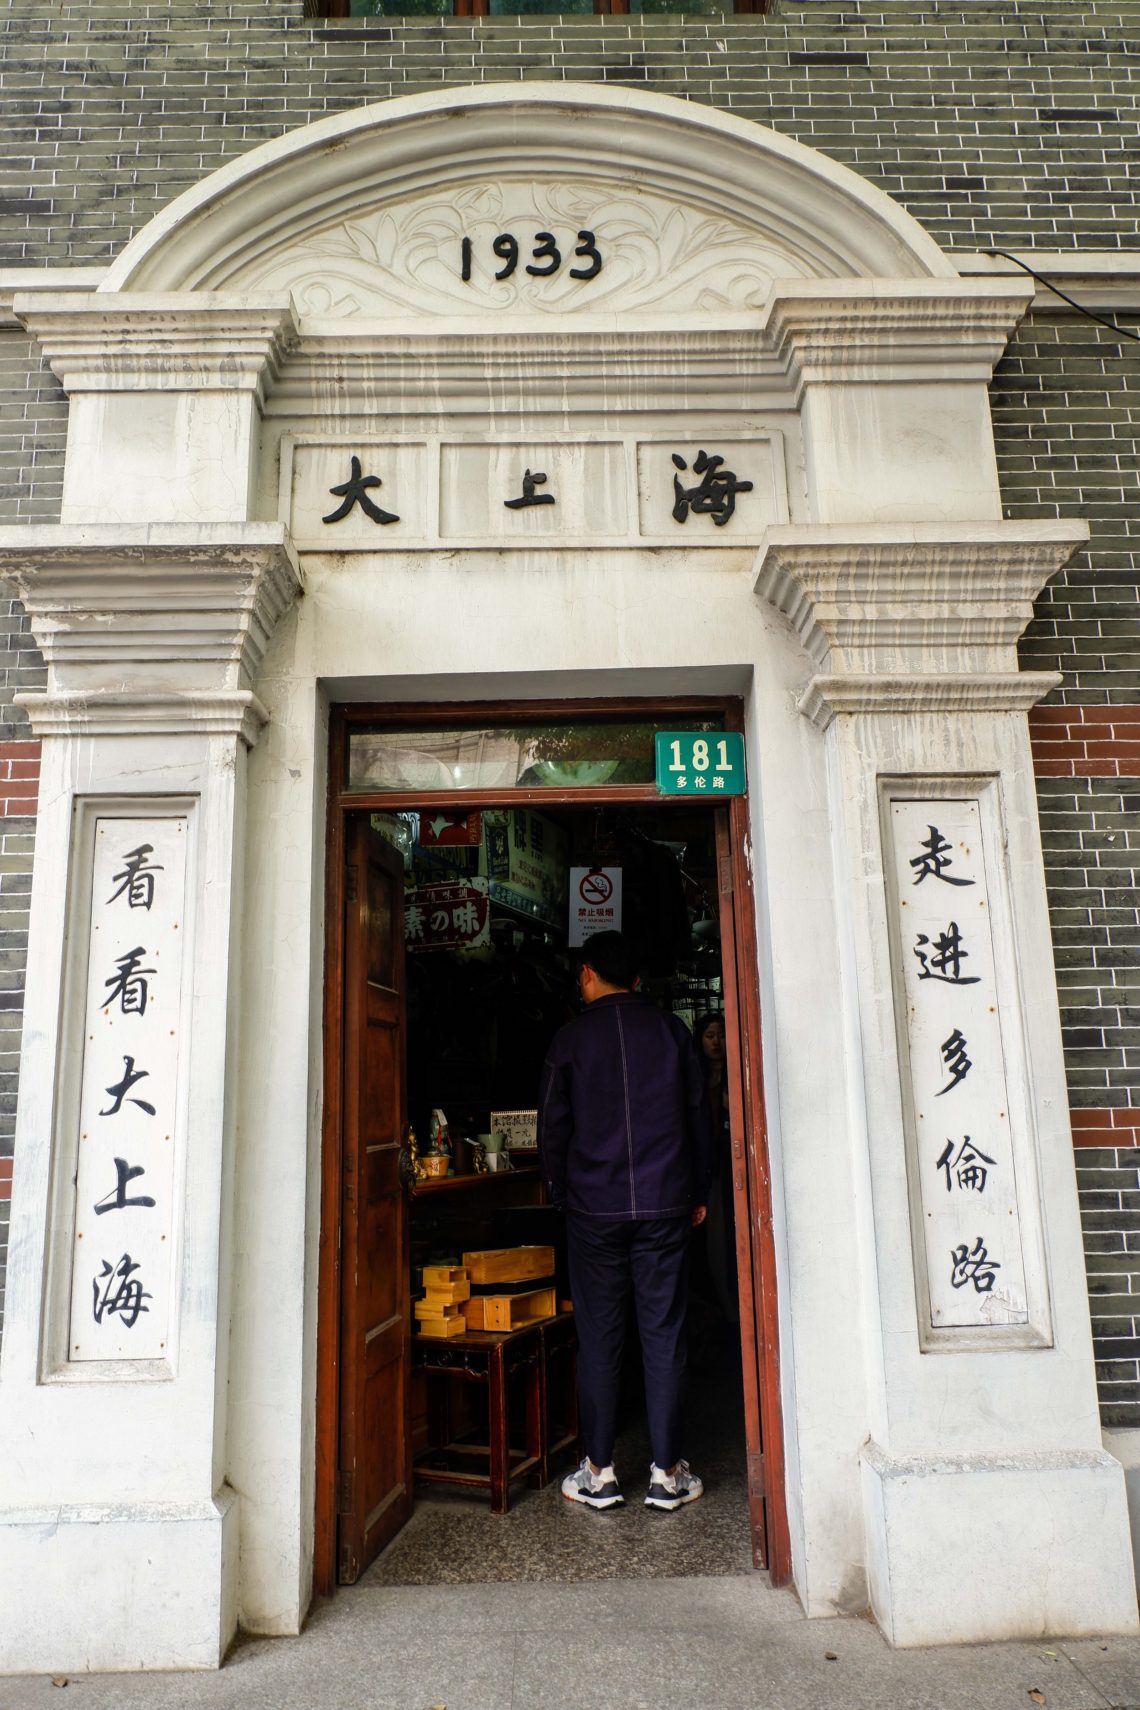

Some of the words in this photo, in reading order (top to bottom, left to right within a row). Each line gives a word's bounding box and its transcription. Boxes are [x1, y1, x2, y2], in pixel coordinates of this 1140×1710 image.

[461, 230, 603, 281] 1933
[321, 448, 752, 527] 大上海
[668, 739, 733, 771] 181
[676, 775, 725, 788] 多伦路
[578, 908, 614, 917] 禁止吸烟
[909, 824, 1001, 1293] 走进多倫路
[93, 843, 165, 1329] 看看大上海
